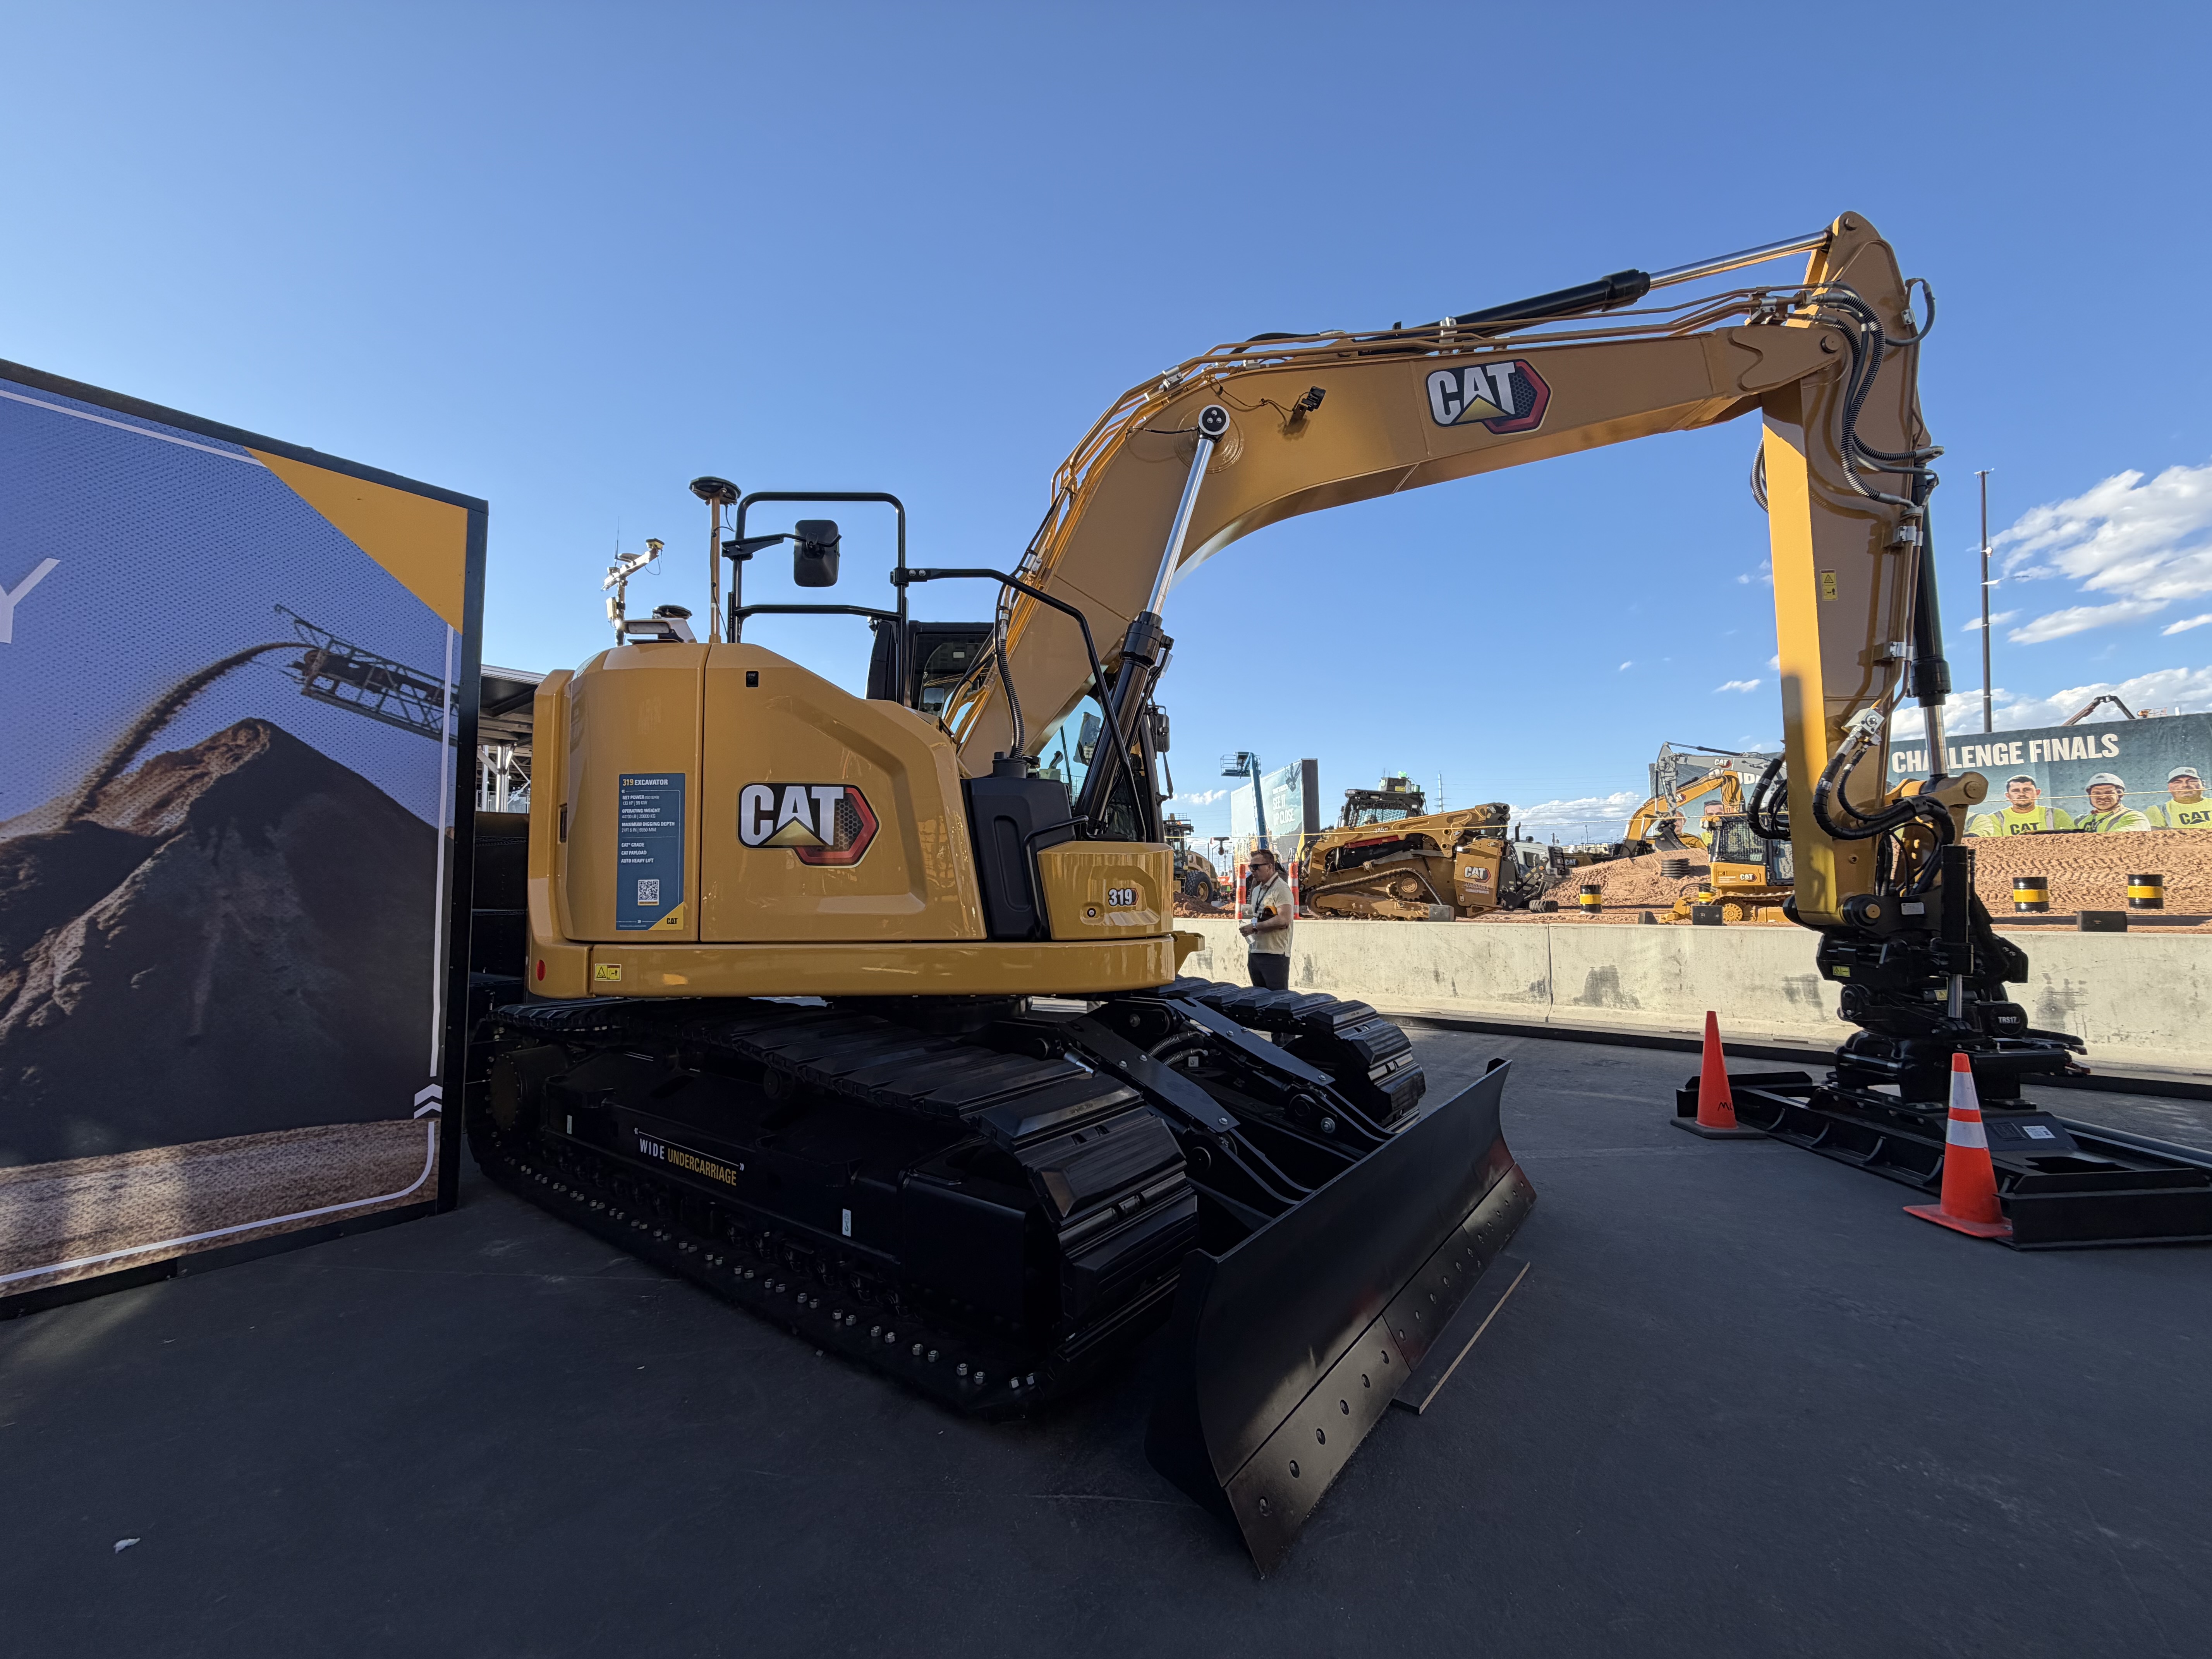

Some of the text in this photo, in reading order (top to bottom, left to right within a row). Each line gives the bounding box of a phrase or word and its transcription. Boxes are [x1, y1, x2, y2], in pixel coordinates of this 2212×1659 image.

[1428, 362, 1515, 424] CAT
[1892, 733, 2119, 773] CHLENGE FINALS
[741, 785, 843, 845] CAT
[2010, 822, 2039, 835] CAT
[2179, 811, 2210, 825] CAT
[1465, 866, 1486, 879] CAT
[1109, 889, 1132, 905] 319
[640, 1138, 737, 1186] WIDE UNDERCARRIAGE
